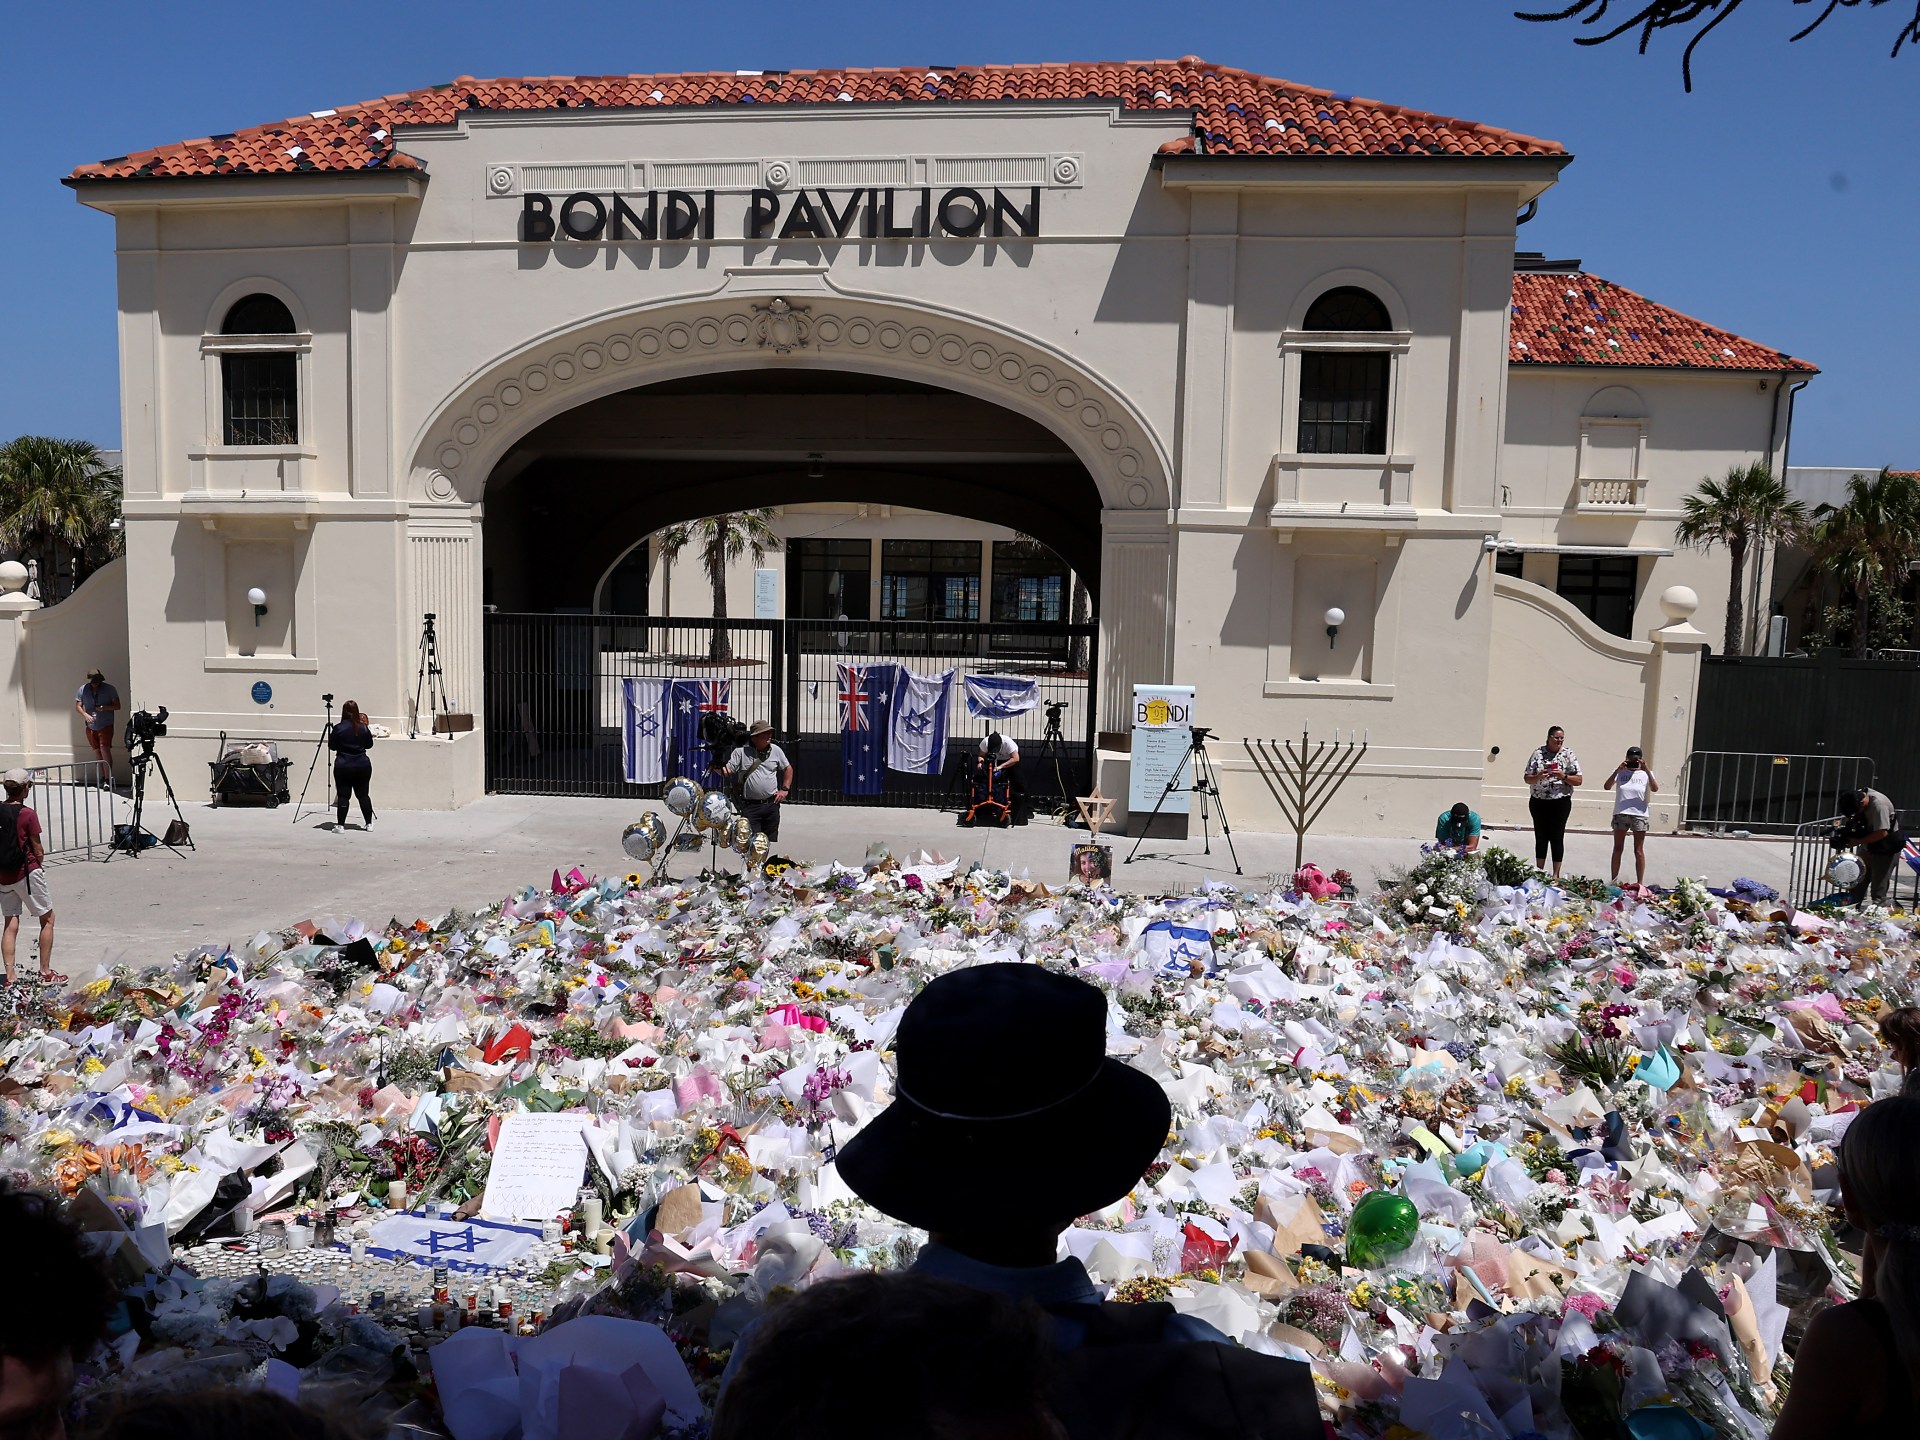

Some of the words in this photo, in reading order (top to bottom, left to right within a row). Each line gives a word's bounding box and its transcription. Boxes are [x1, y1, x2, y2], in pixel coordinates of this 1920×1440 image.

[524, 190, 714, 241] BONDI
[752, 186, 1039, 239] PAVILION
[1074, 846, 1099, 855] Matilda
